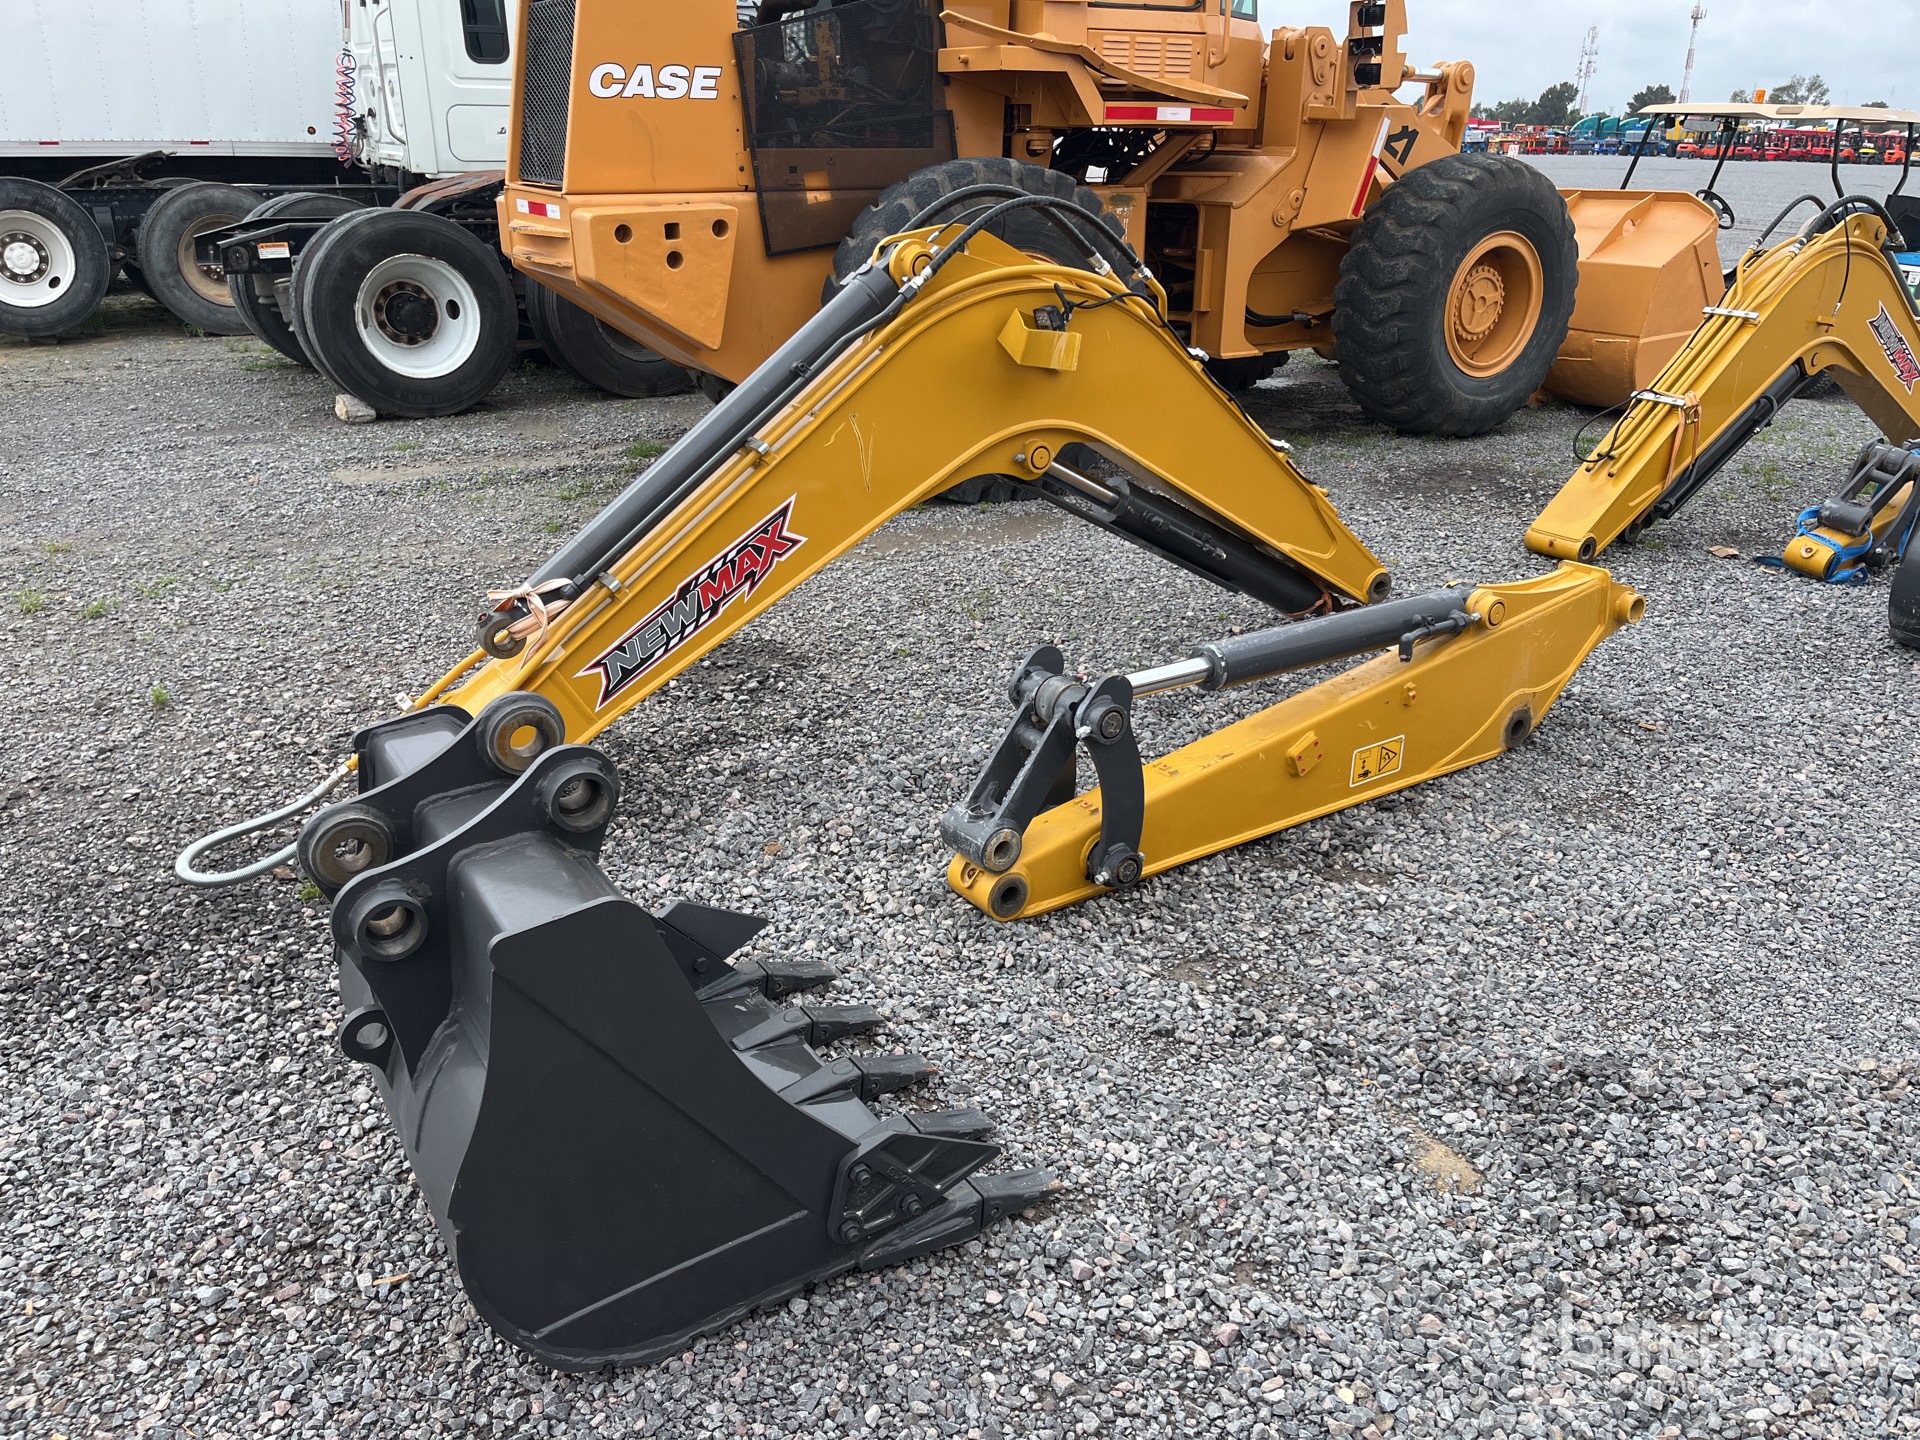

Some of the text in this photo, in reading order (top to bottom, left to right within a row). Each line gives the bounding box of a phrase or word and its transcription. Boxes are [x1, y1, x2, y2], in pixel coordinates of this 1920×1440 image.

[589, 62, 722, 99] CASE
[1873, 312, 1919, 387] NEWMAX
[603, 518, 791, 685] NEWMAX
